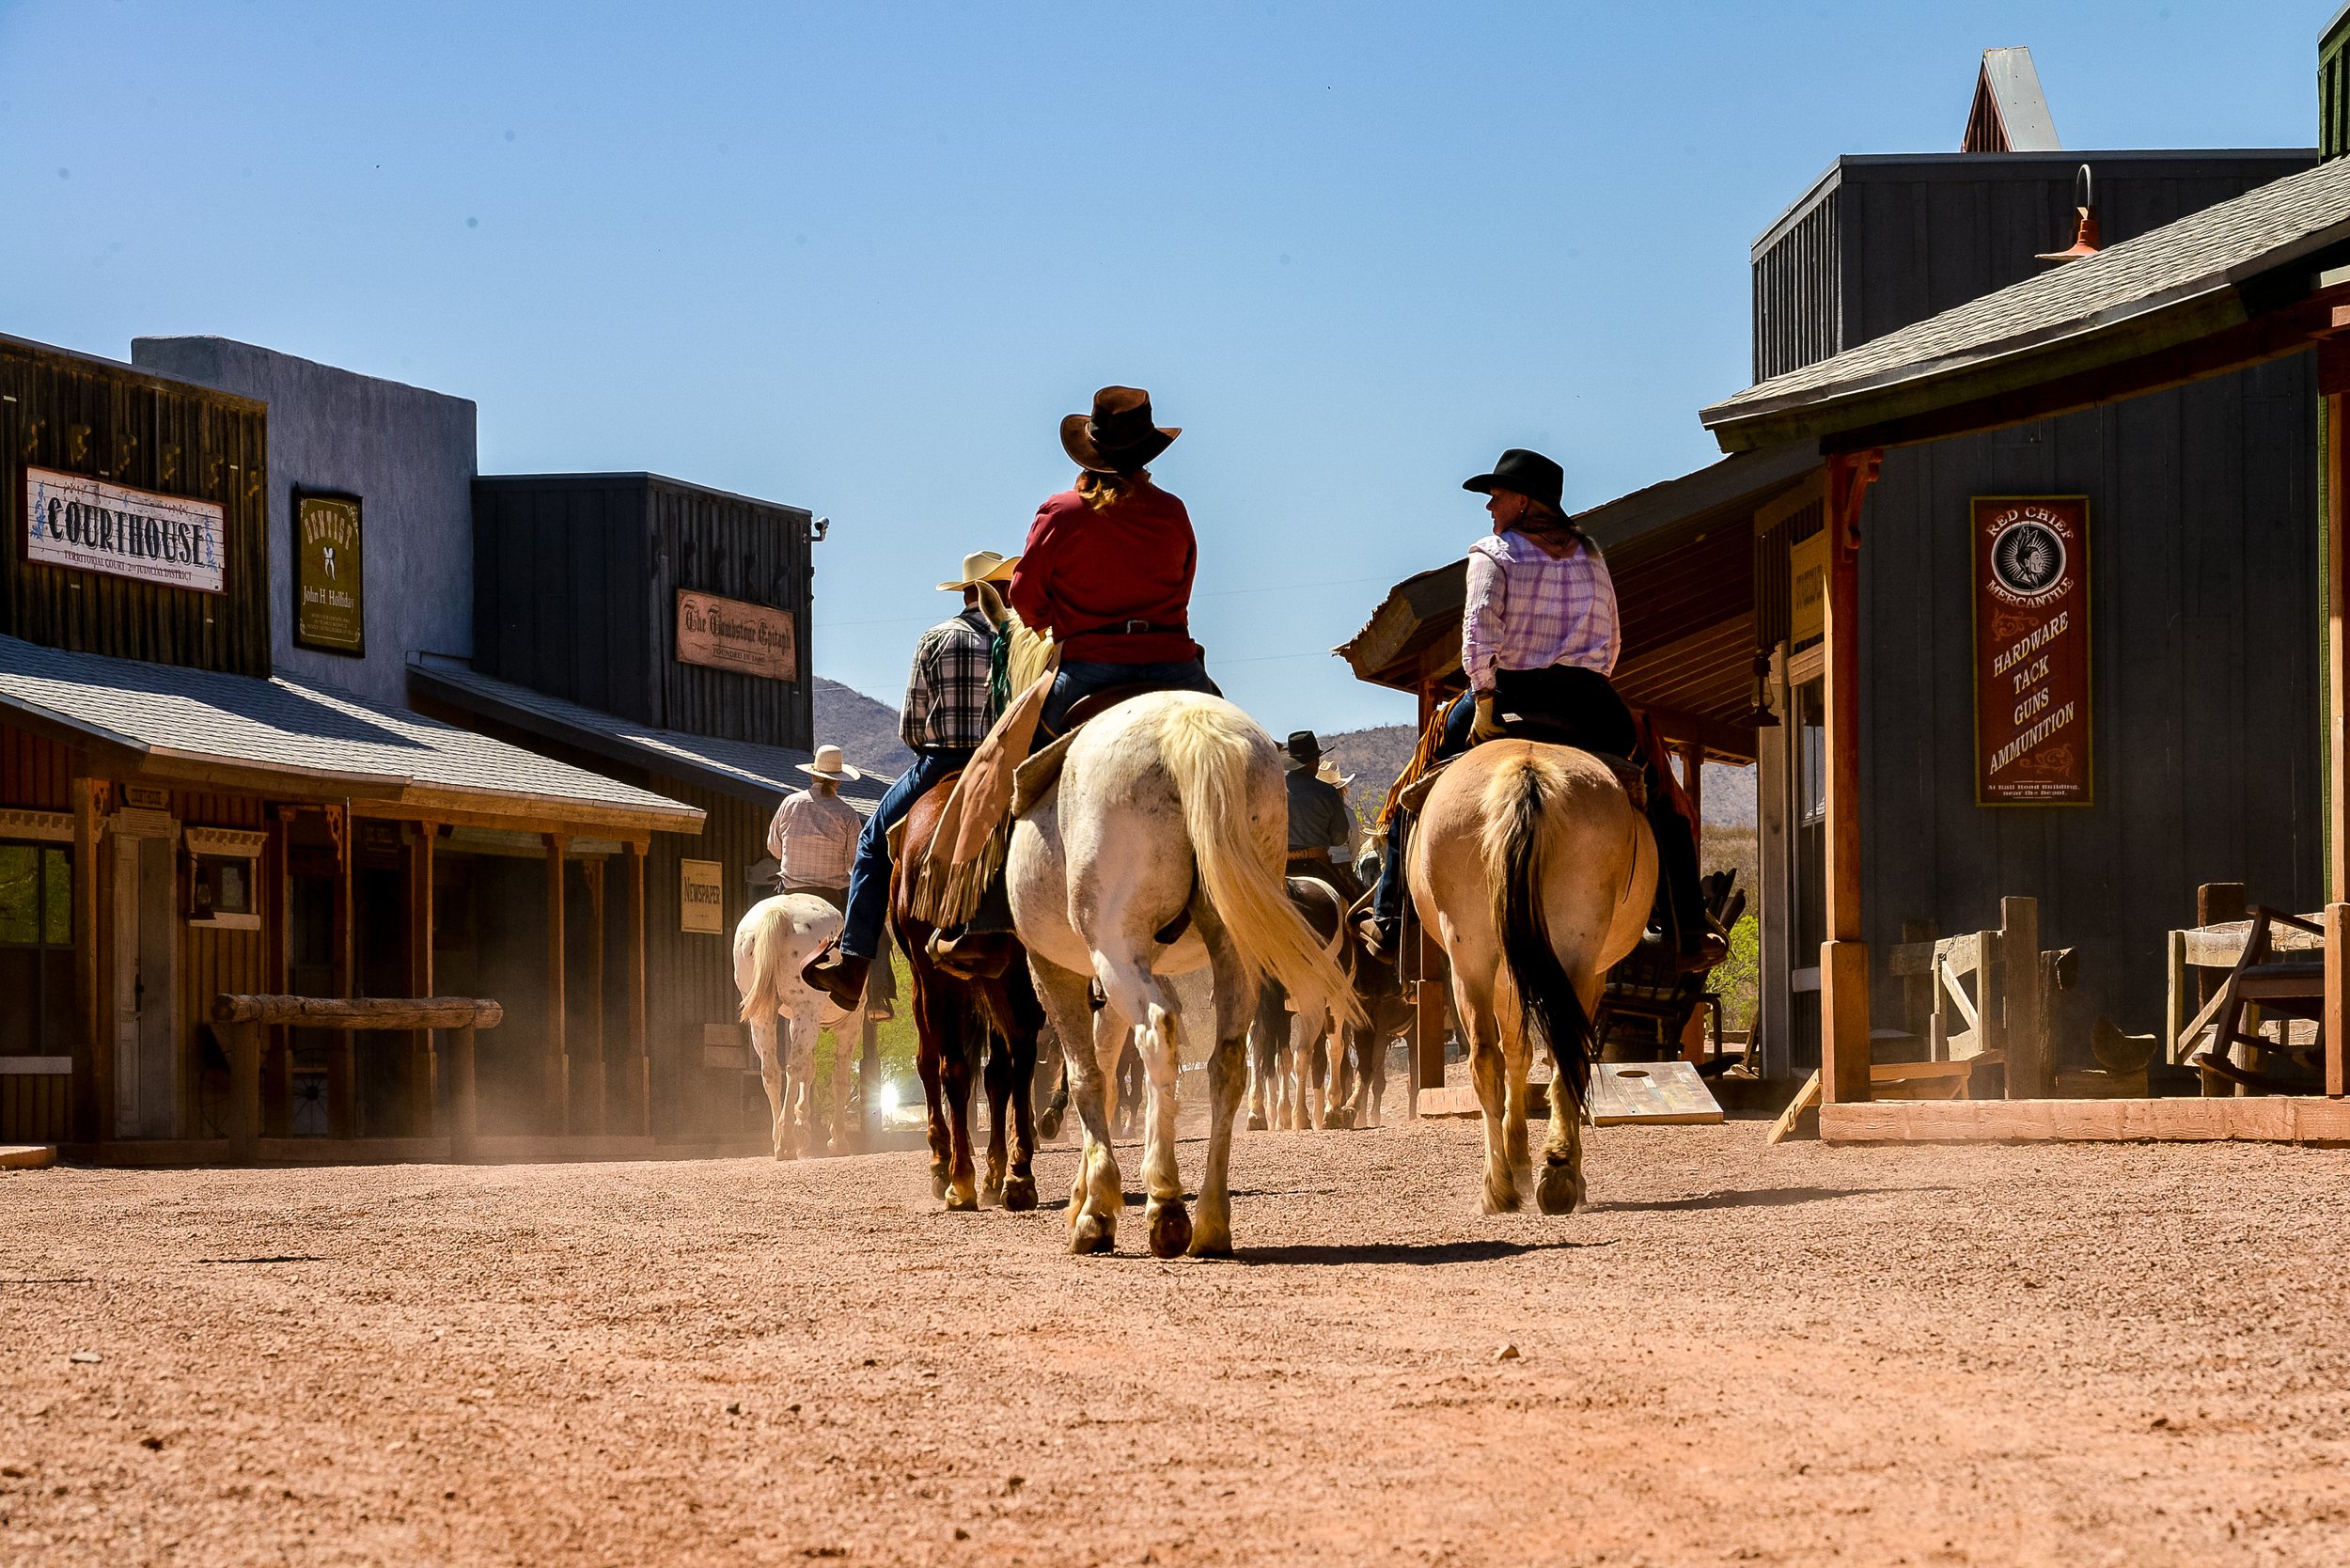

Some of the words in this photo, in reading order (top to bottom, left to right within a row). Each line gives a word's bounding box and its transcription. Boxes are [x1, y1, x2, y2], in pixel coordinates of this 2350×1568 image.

[47, 496, 206, 568] COURTHOUSE
[304, 510, 353, 551] DENTIST
[1985, 509, 2018, 538] RED
[2025, 506, 2074, 541] CHIEF
[64, 549, 103, 567] TERRITORIAL
[104, 557, 125, 572] COURT
[136, 564, 164, 577] JUDICIAL
[164, 568, 193, 581] DISTRICT
[302, 585, 319, 606] John
[329, 589, 354, 614] Holliday
[1985, 577, 2075, 609] MERCANTILE
[682, 599, 706, 634] The
[707, 604, 756, 642] Tombstone
[758, 618, 791, 655] Epitaph
[1993, 611, 2068, 677] HARDWARE
[713, 648, 743, 659] FOUNDED
[2013, 655, 2049, 695] TACK
[2013, 687, 2049, 726] GUNS
[1989, 701, 2075, 775] AMMUNITION
[683, 876, 721, 904] NEWSPAPER
